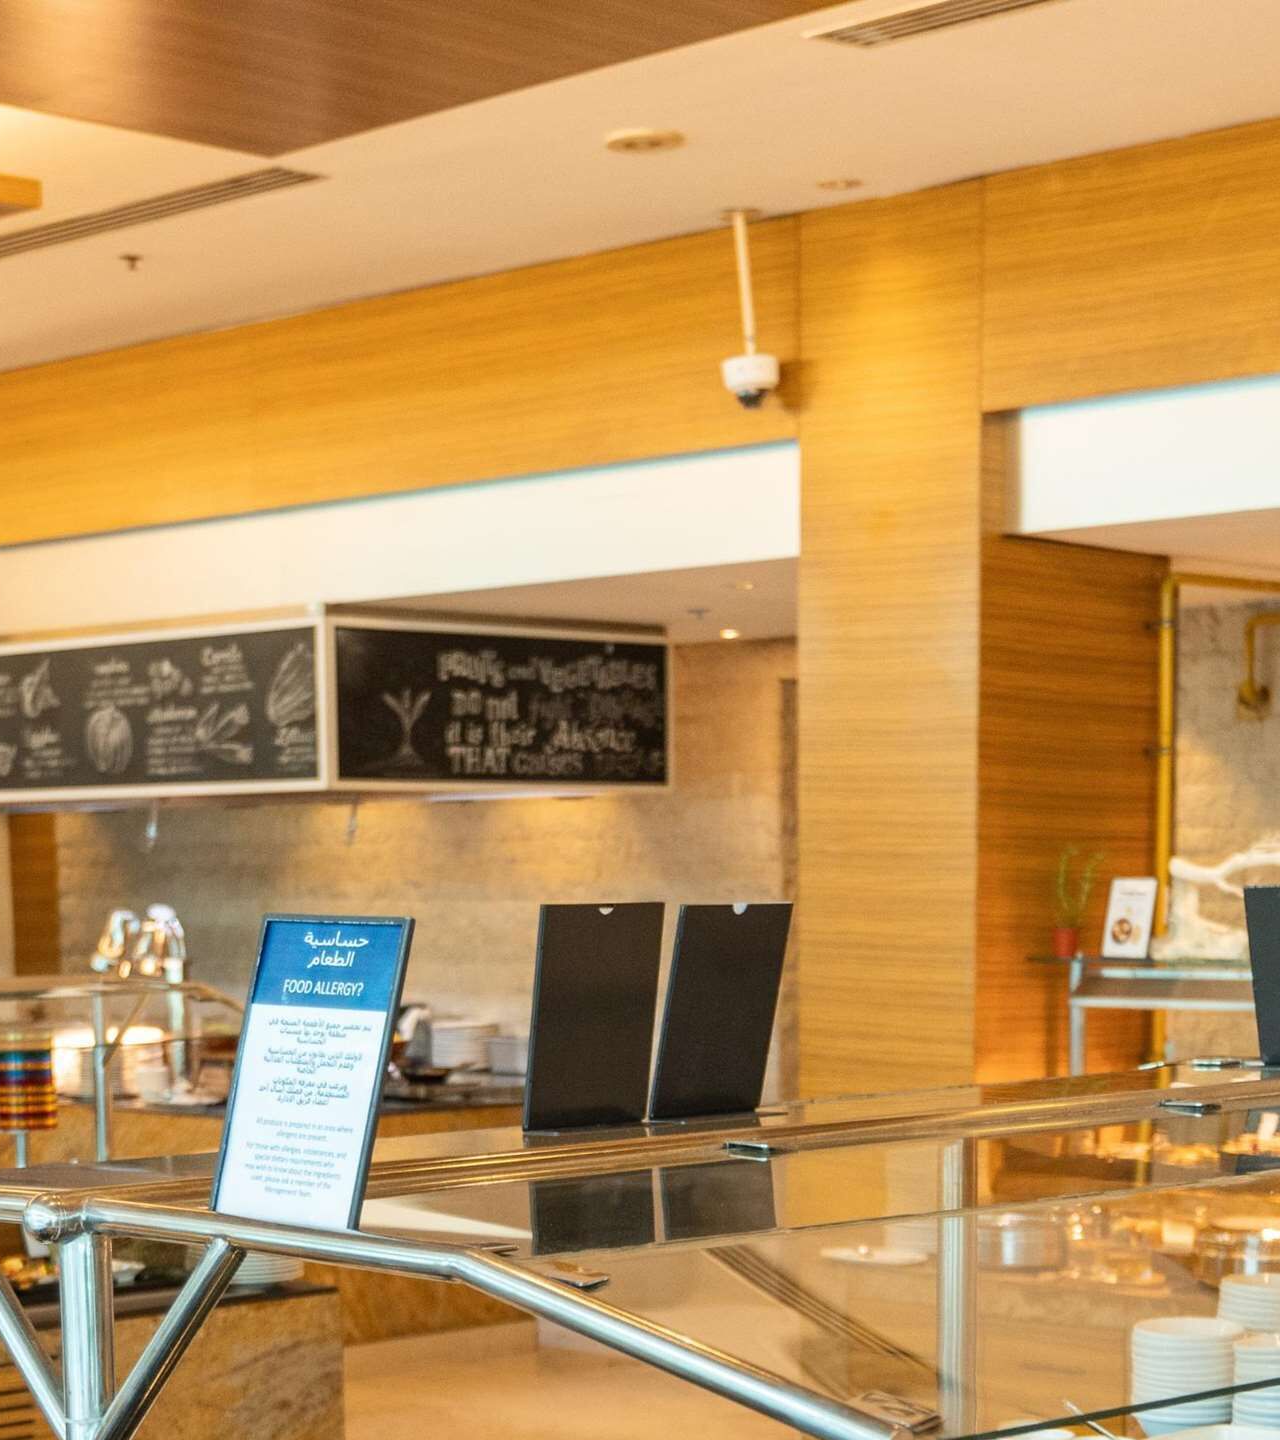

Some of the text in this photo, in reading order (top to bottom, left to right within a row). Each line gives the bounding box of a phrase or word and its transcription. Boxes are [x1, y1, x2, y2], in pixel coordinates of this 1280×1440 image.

[304, 930, 369, 949] حساسية
[307, 950, 355, 968] الطعام
[283, 979, 365, 997] FOOD ALLERGY?
